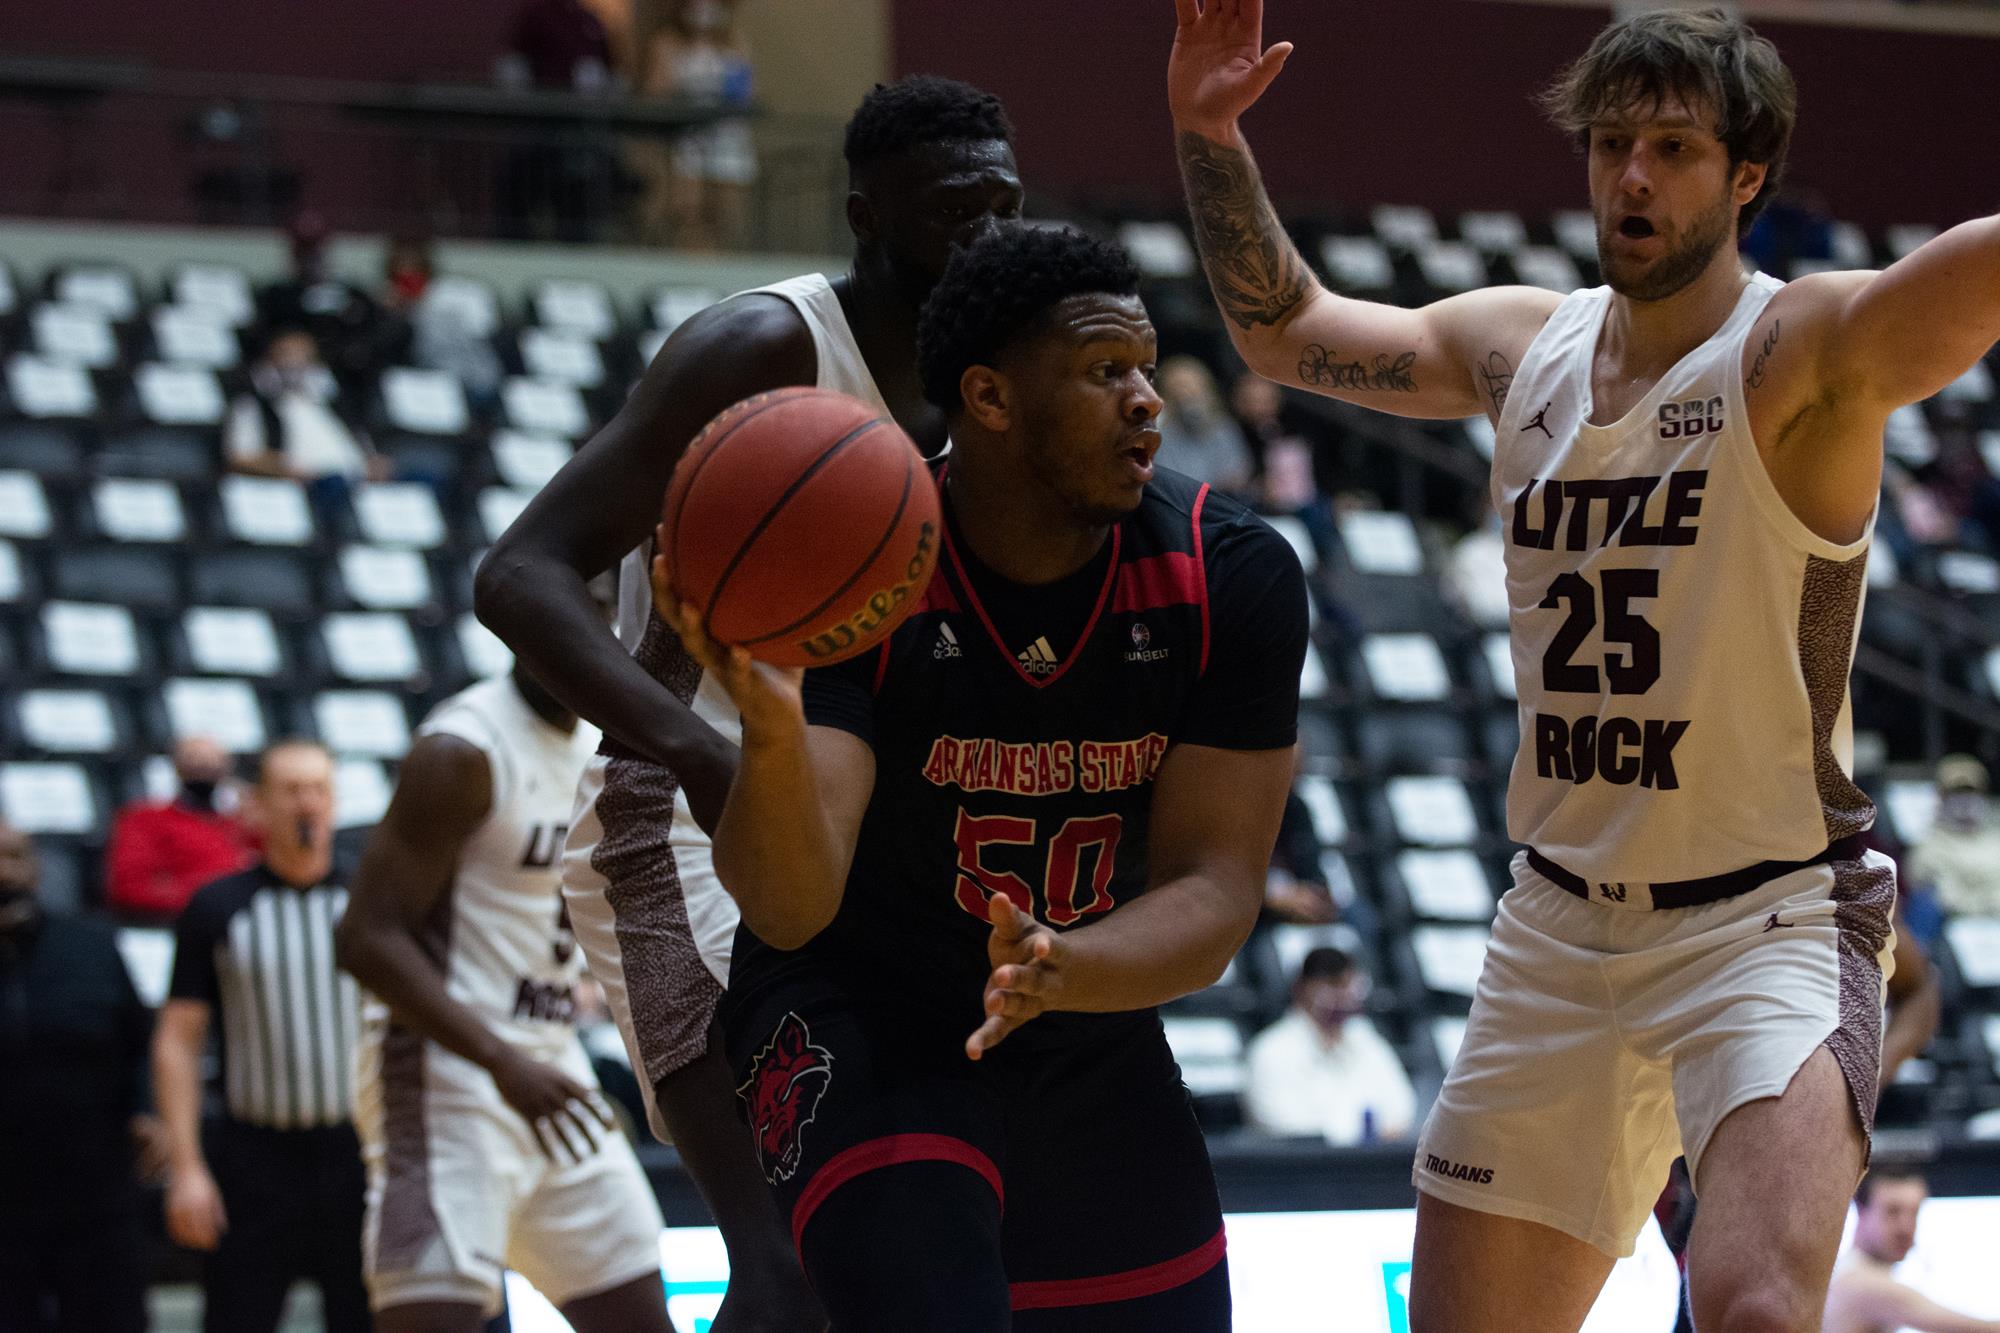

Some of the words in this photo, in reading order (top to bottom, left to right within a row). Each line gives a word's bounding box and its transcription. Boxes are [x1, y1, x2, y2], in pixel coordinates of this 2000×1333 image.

[1658, 396, 1725, 440] SBC
[1512, 469, 1709, 551] LITTLE
[1538, 568, 1661, 696] 25
[922, 734, 1074, 797] ARKANSAS
[1079, 732, 1168, 792] STATE
[1536, 712, 1692, 791] ROCK
[954, 805, 1123, 927] 50
[1425, 1153, 1495, 1185] TROJANS
